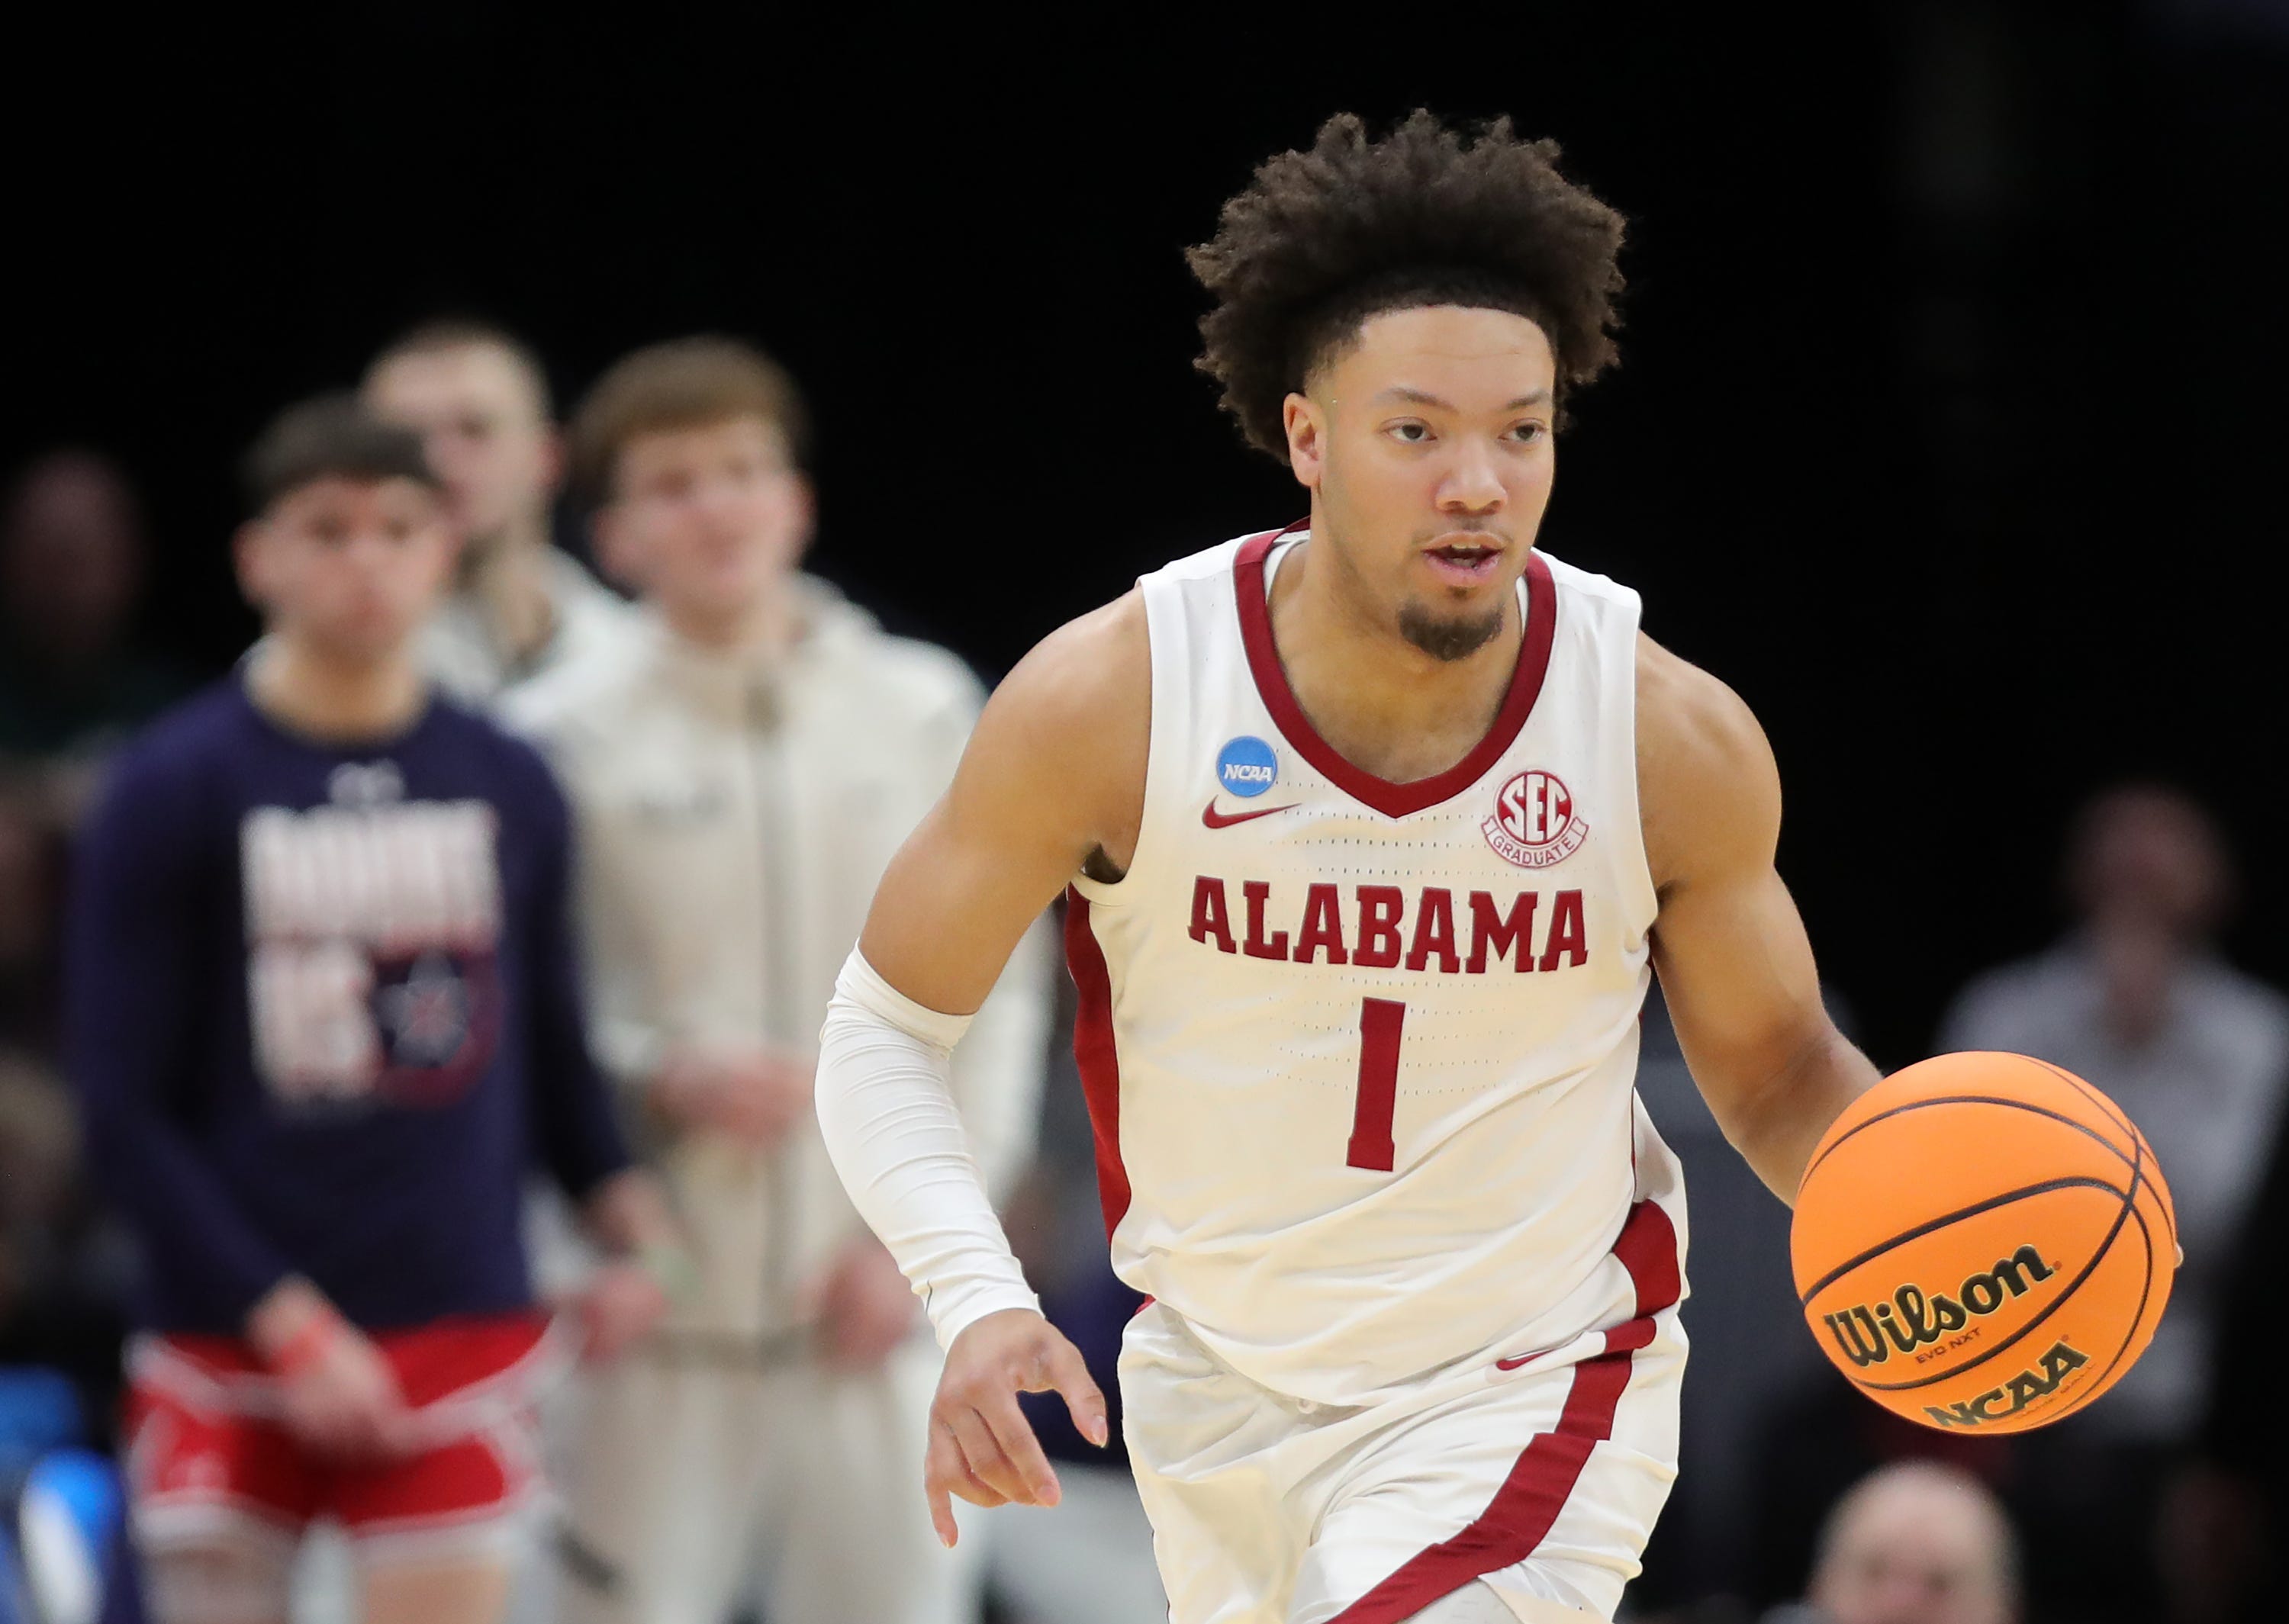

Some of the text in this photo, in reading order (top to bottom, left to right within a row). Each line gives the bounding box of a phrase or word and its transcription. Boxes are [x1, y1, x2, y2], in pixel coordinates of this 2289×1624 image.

[1224, 763, 1273, 782] NCAA
[1501, 773, 1569, 842] SEC
[1492, 835, 1576, 866] GRADUATE
[1187, 875, 1589, 974] ALABAMA
[1346, 996, 1406, 1172] 1
[1822, 1243, 2054, 1368] Wilson
[1915, 1327, 1980, 1364] EVO NXT
[1922, 1339, 2091, 1427] NCAA
